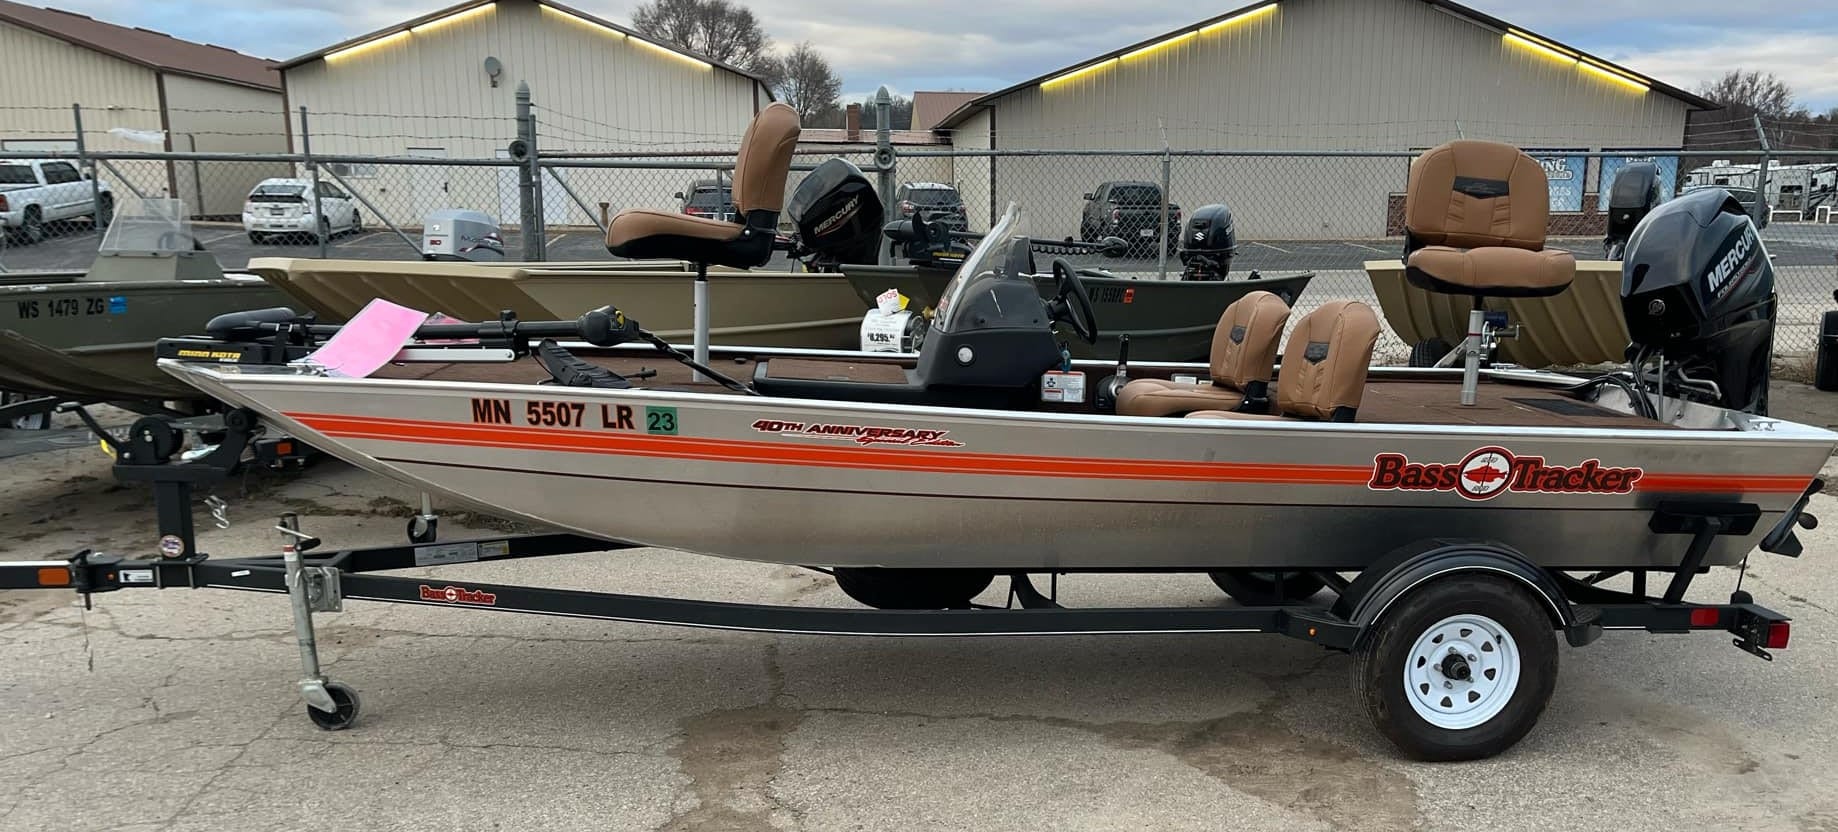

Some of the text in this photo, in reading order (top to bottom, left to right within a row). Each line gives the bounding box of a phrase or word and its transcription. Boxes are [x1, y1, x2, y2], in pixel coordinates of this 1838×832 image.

[814, 194, 860, 235] MERCURY
[17, 298, 105, 319] WS 1479 ZG
[471, 398, 675, 431] MN 5507 LR 23
[752, 420, 947, 440] 40TH ANNIVERSARY
[1369, 454, 1642, 493] Bass Tracker
[420, 585, 495, 605] Bass Tracker
